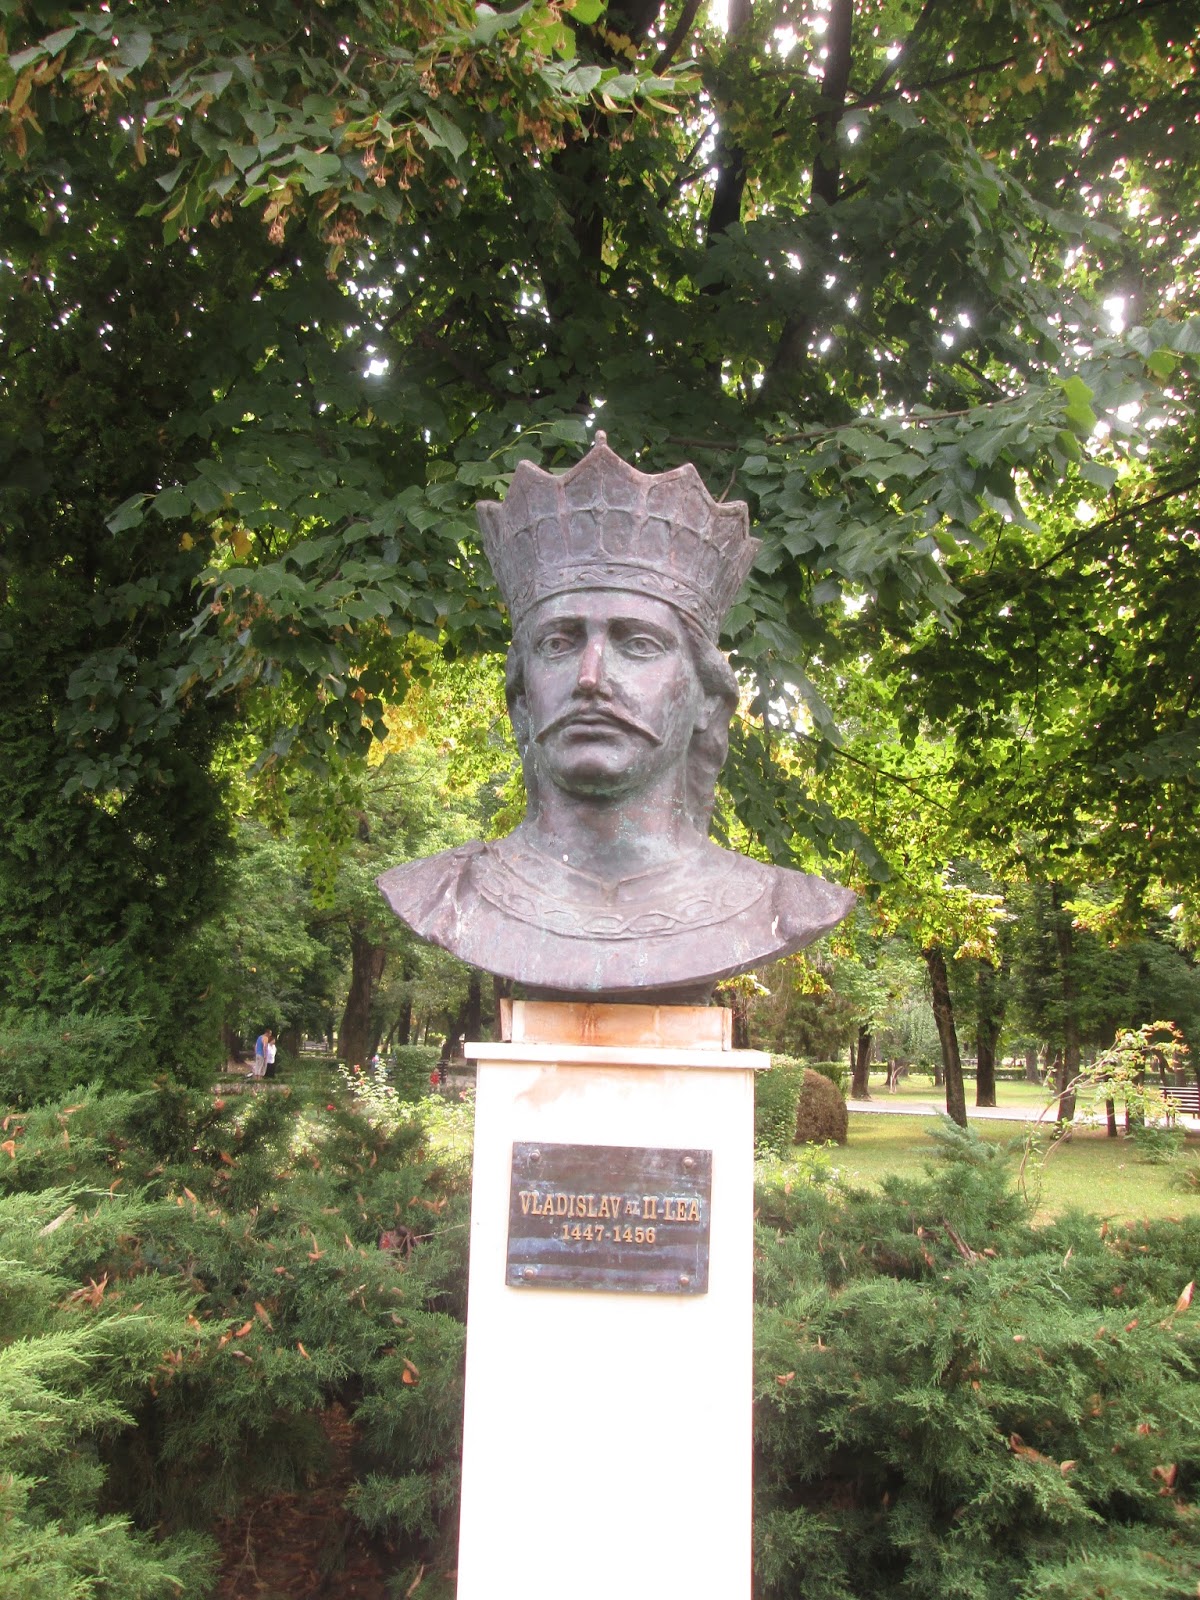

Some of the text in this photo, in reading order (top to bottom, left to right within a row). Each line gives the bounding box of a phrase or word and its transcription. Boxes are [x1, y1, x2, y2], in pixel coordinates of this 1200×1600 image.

[519, 1191, 621, 1218] VLADISLAV
[642, 1196, 700, 1222] II-LEA
[562, 1224, 656, 1243] 1447-1456
